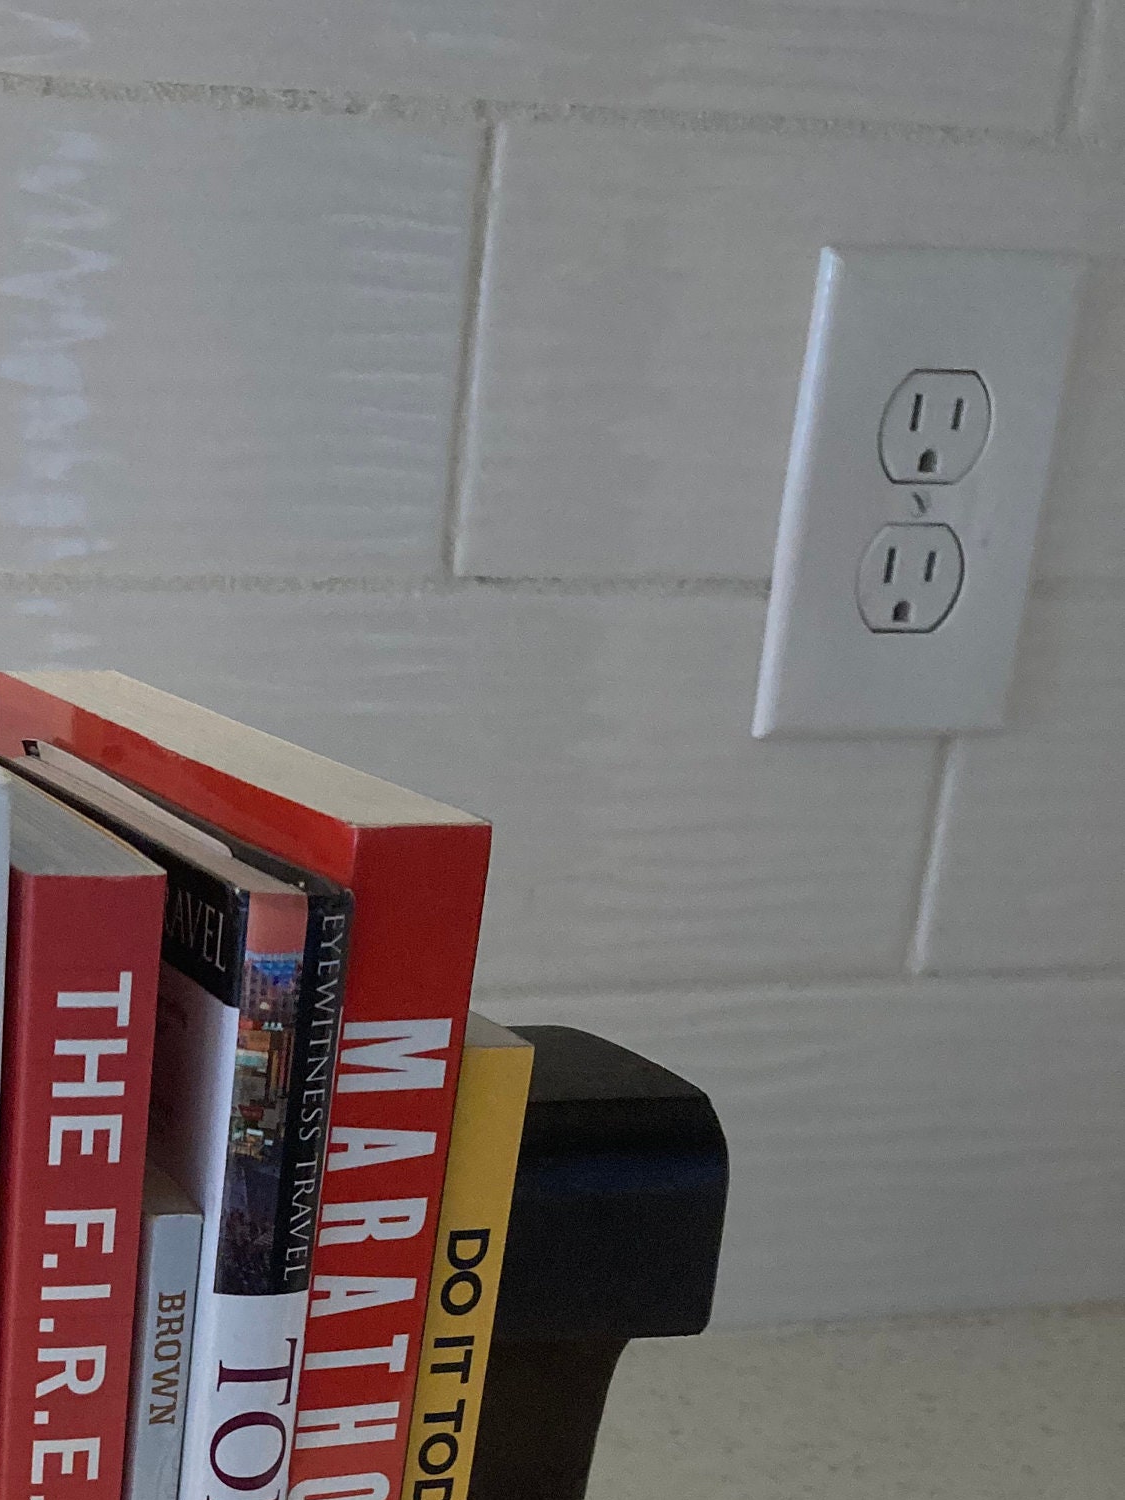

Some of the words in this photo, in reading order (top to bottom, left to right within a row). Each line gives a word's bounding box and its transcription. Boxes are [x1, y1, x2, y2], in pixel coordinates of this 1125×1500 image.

[47, 970, 132, 1167] THE
[298, 913, 346, 1141] EYEWITNESS
[283, 1158, 318, 1281] TRAVEL
[439, 1227, 491, 1317] DO
[148, 1289, 186, 1425] BROWN
[429, 1335, 475, 1384] IT
